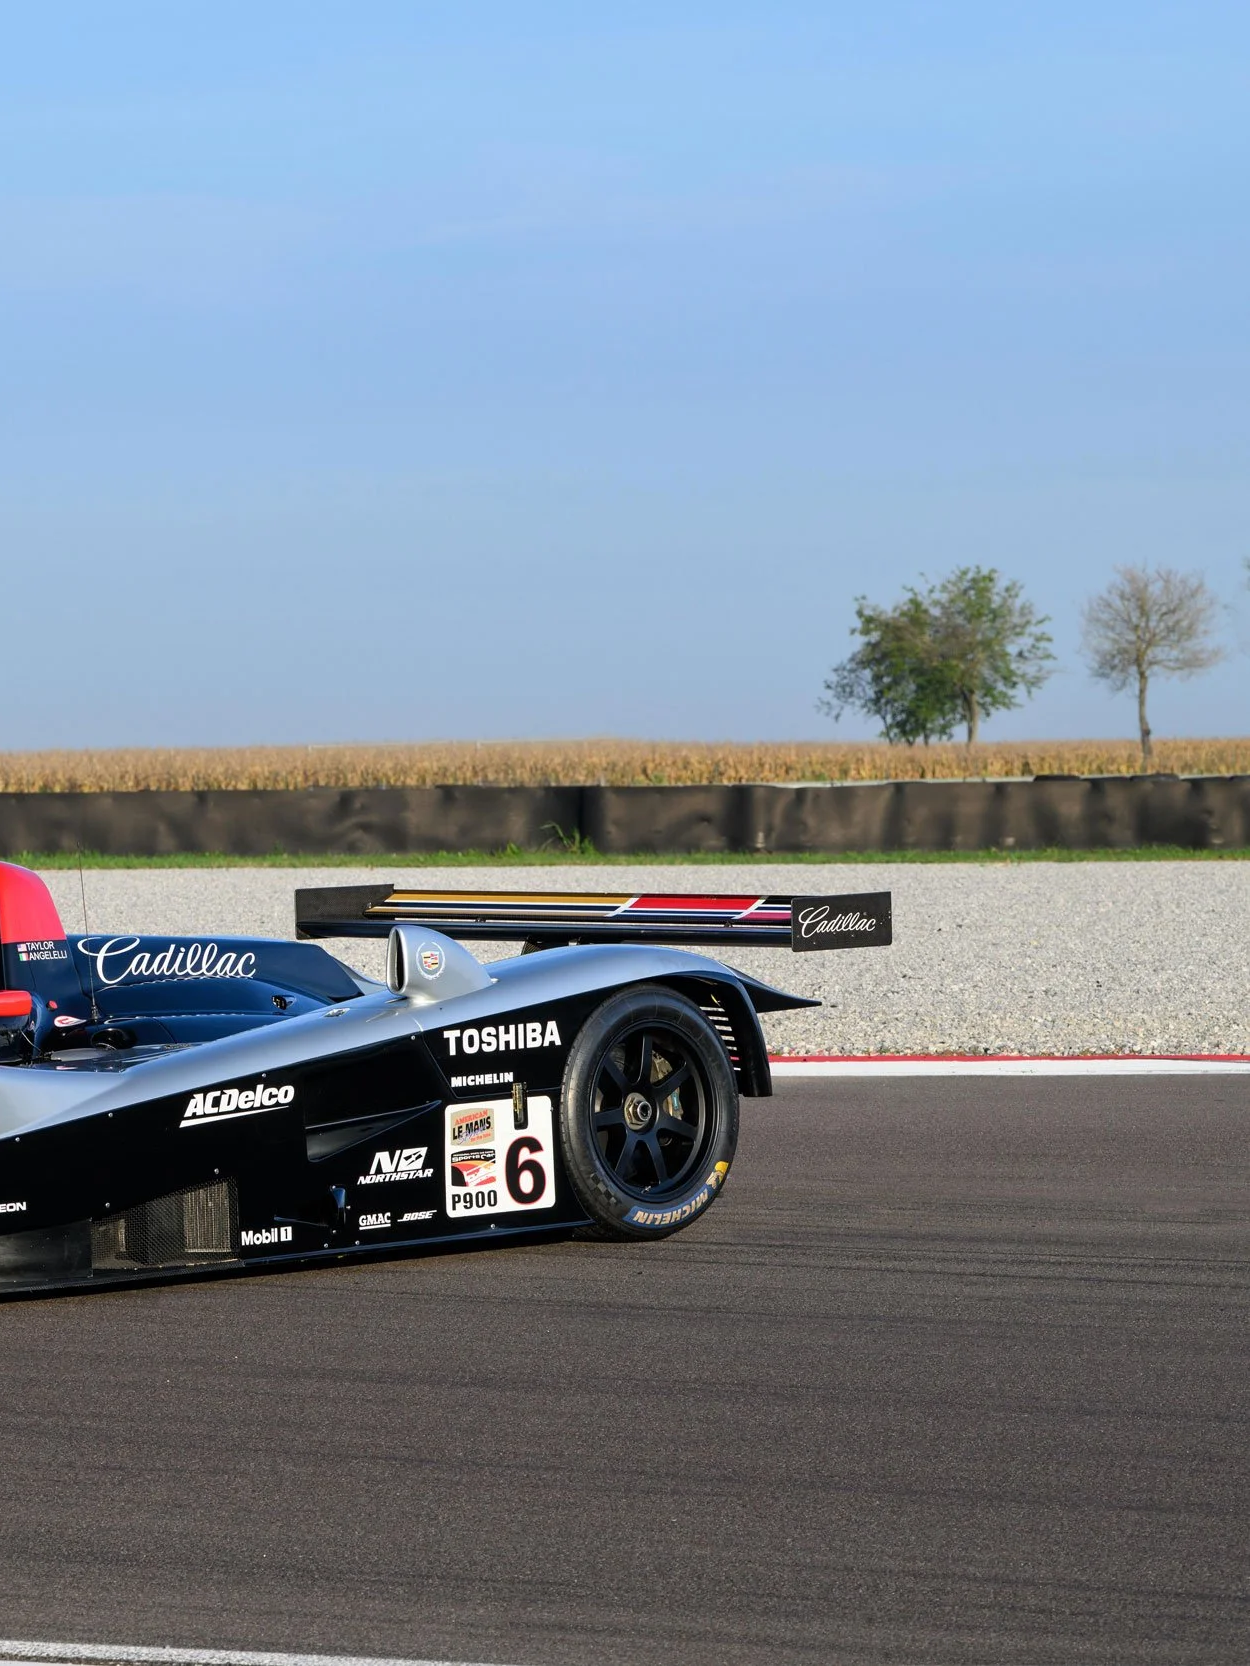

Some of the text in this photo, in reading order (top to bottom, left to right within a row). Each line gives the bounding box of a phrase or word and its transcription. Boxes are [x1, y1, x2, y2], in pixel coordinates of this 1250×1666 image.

[798, 905, 876, 938] Cadillac
[26, 941, 55, 951] TAYLOR
[30, 950, 68, 960] ANGELELLI
[77, 936, 257, 985] Cadillac
[443, 1020, 562, 1056] TOSHIBA
[451, 1072, 514, 1088] MICHELIN
[182, 1084, 295, 1118] ACDelco
[454, 1109, 489, 1125] AMERICAN
[452, 1116, 492, 1141] LE MANS
[357, 1168, 434, 1185] NORTHSTAR
[505, 1136, 546, 1205] 6
[452, 1189, 498, 1211] P900
[633, 1188, 708, 1225] MICHELIN
[358, 1212, 391, 1226] GMAC
[399, 1210, 436, 1221] BOSE
[241, 1227, 278, 1246] Mobil
